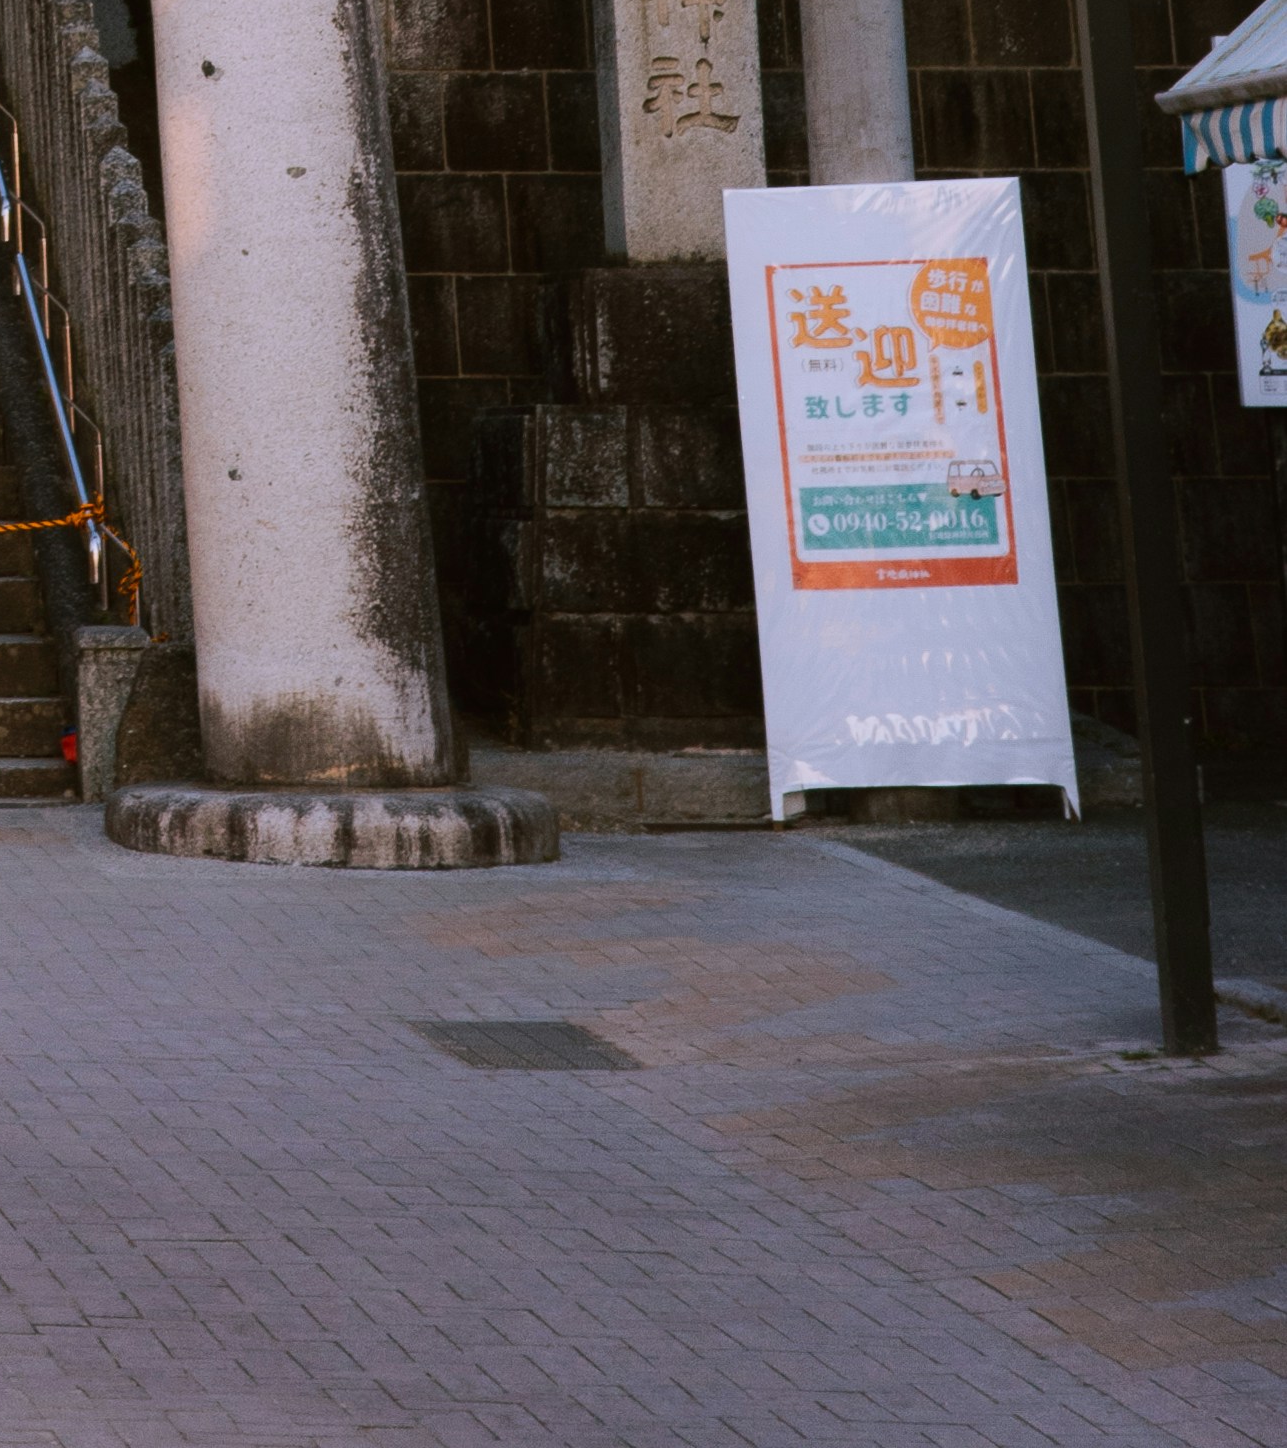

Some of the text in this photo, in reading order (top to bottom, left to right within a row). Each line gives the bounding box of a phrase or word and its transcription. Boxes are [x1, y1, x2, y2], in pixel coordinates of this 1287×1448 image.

[927, 268, 985, 293] 歩行が
[920, 290, 977, 316] 困難な
[804, 392, 912, 419] 致します
[832, 508, 984, 534] 0940-52-0016
